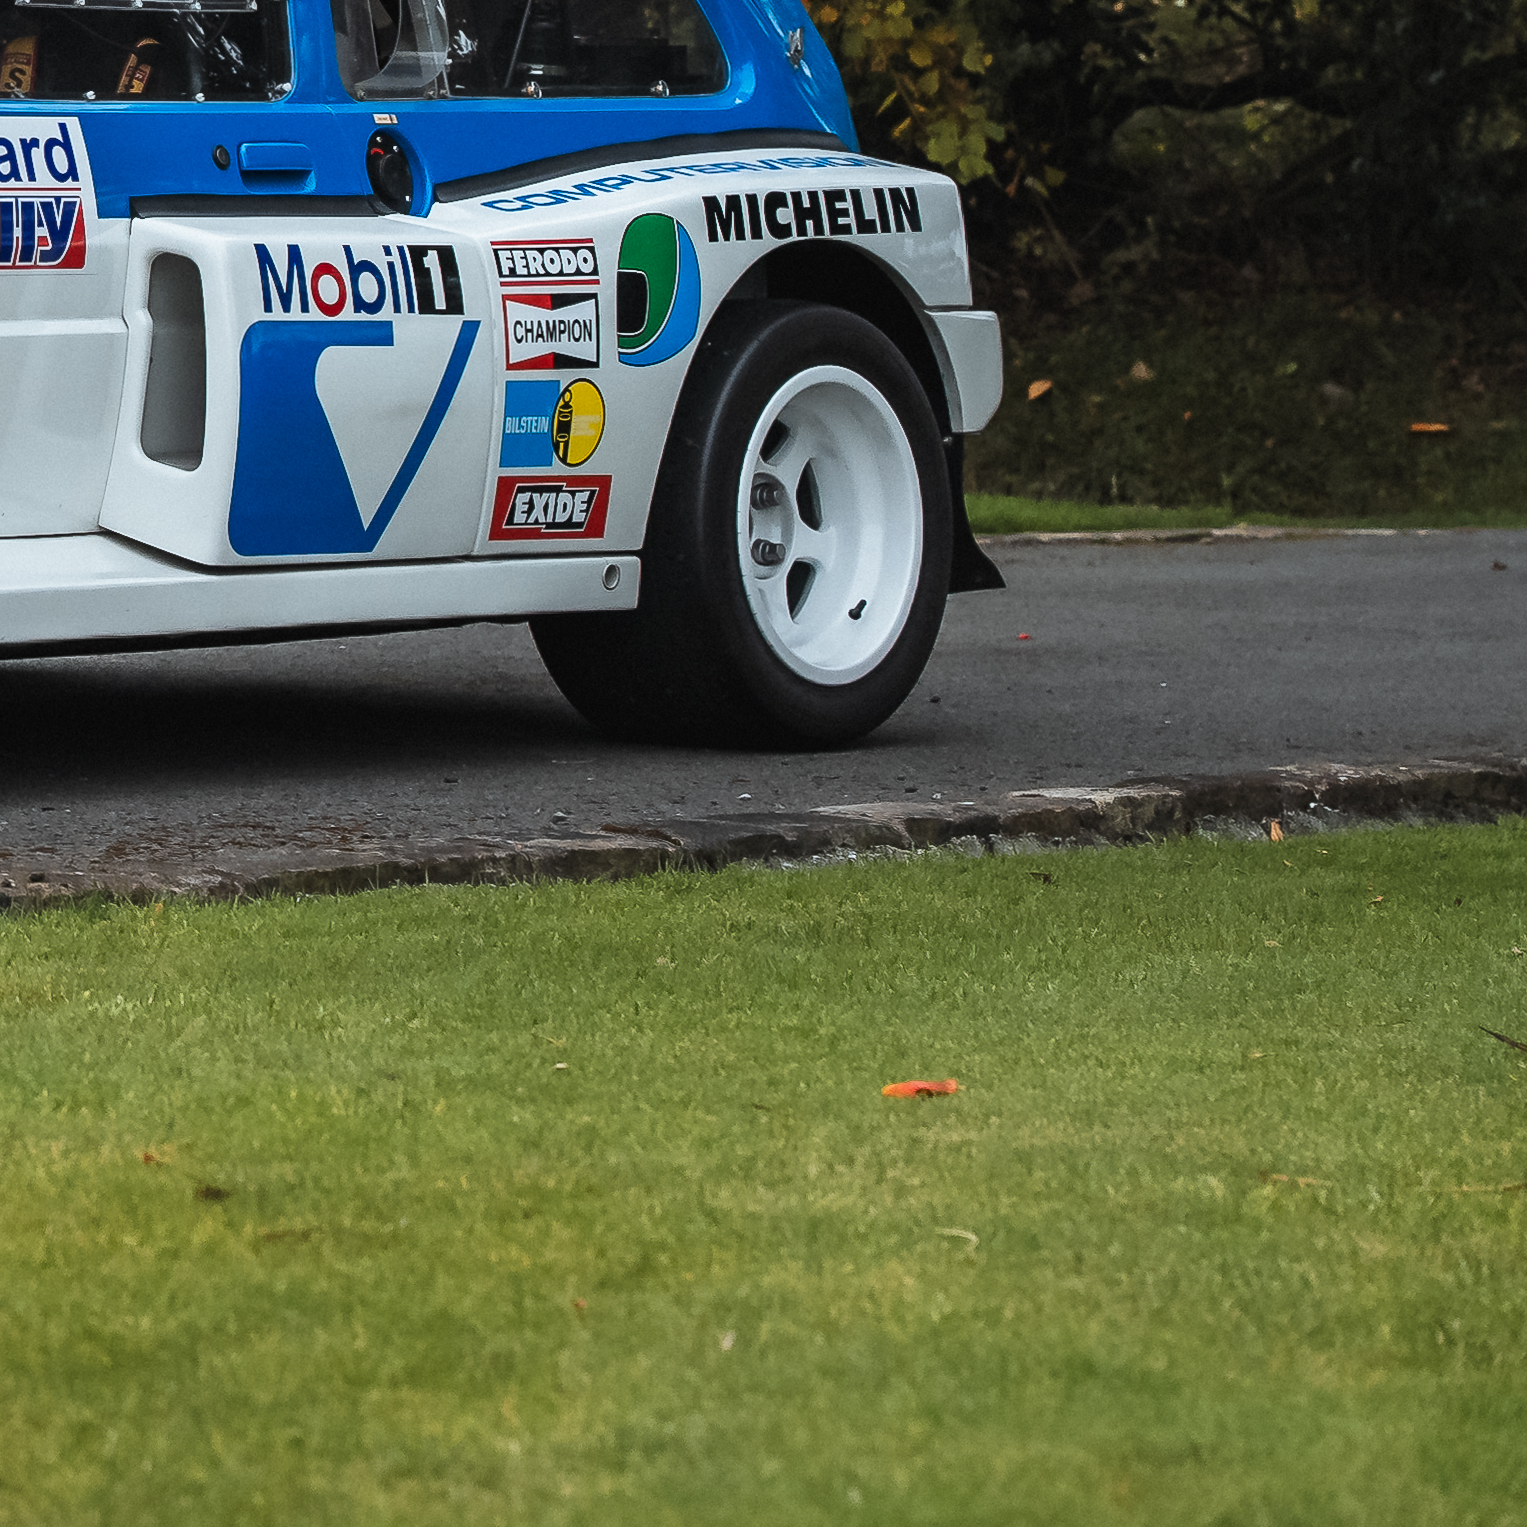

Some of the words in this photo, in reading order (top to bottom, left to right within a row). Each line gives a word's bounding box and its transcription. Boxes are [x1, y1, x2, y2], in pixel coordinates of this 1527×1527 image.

[480, 154, 901, 212] COMPUTERVISION
[702, 186, 923, 243] MICHELIN
[497, 247, 595, 277] FERODO
[253, 243, 416, 317] Mobil
[513, 318, 593, 344] CHAMPION
[504, 416, 550, 434] BILSTEIN
[513, 490, 590, 525] EXIDE
